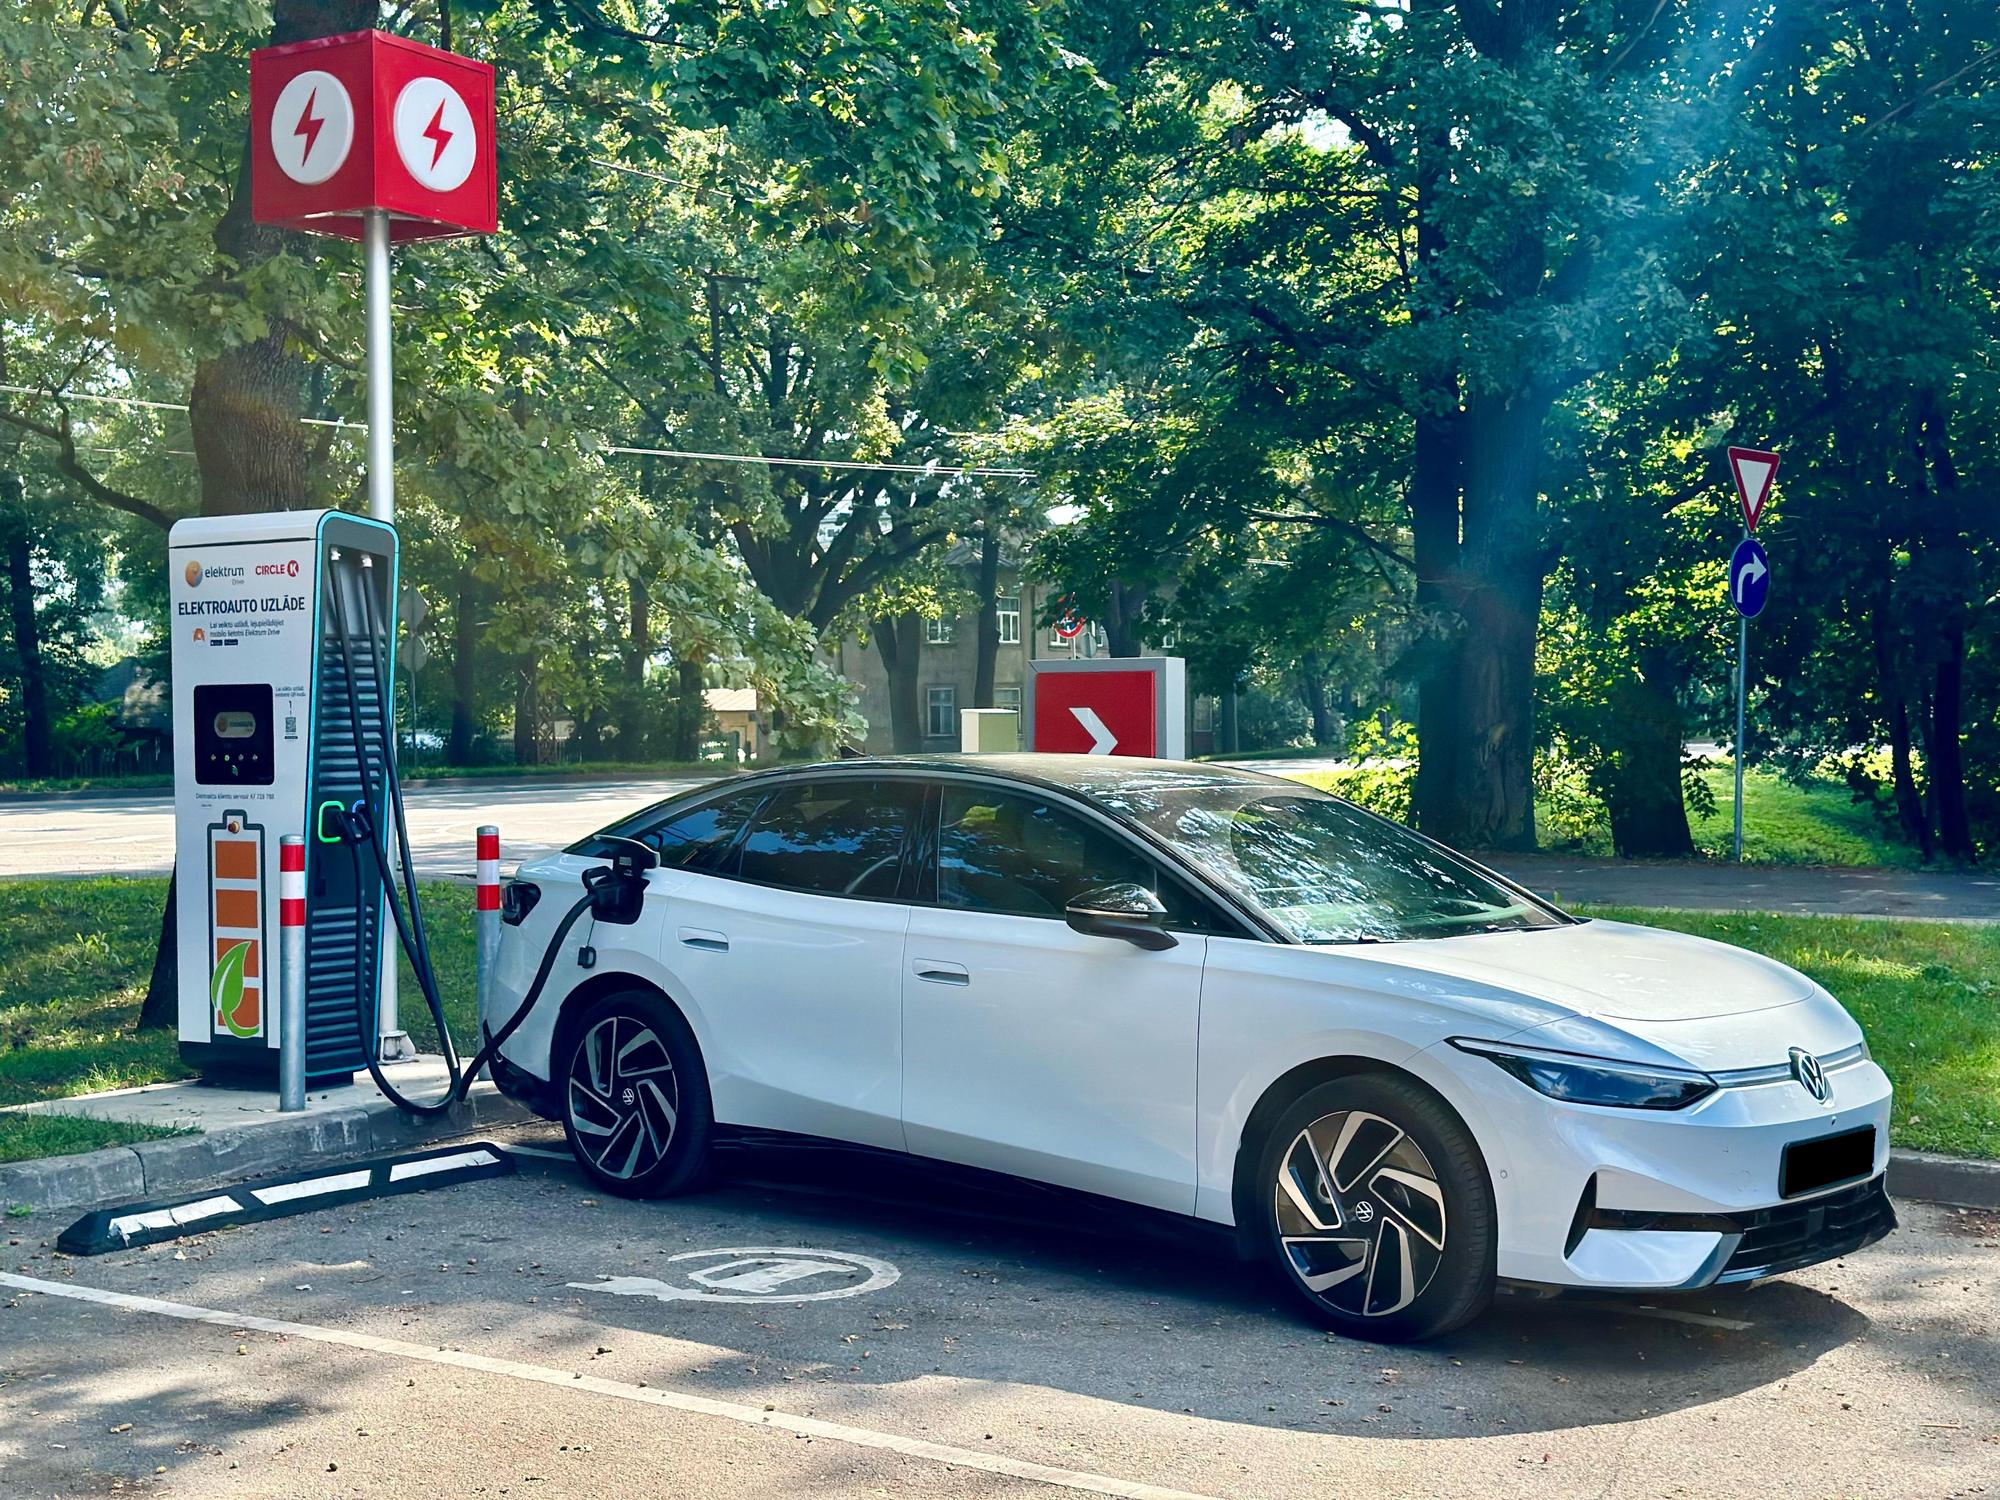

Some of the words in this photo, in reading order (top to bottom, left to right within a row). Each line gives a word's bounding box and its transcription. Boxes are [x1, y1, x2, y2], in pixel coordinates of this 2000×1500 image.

[205, 566, 245, 578] elektrum
[255, 564, 285, 576] CIRCLE
[287, 560, 299, 577] K
[178, 599, 258, 616] ELEKTROAUTO
[261, 595, 305, 612] UZLĀDE
